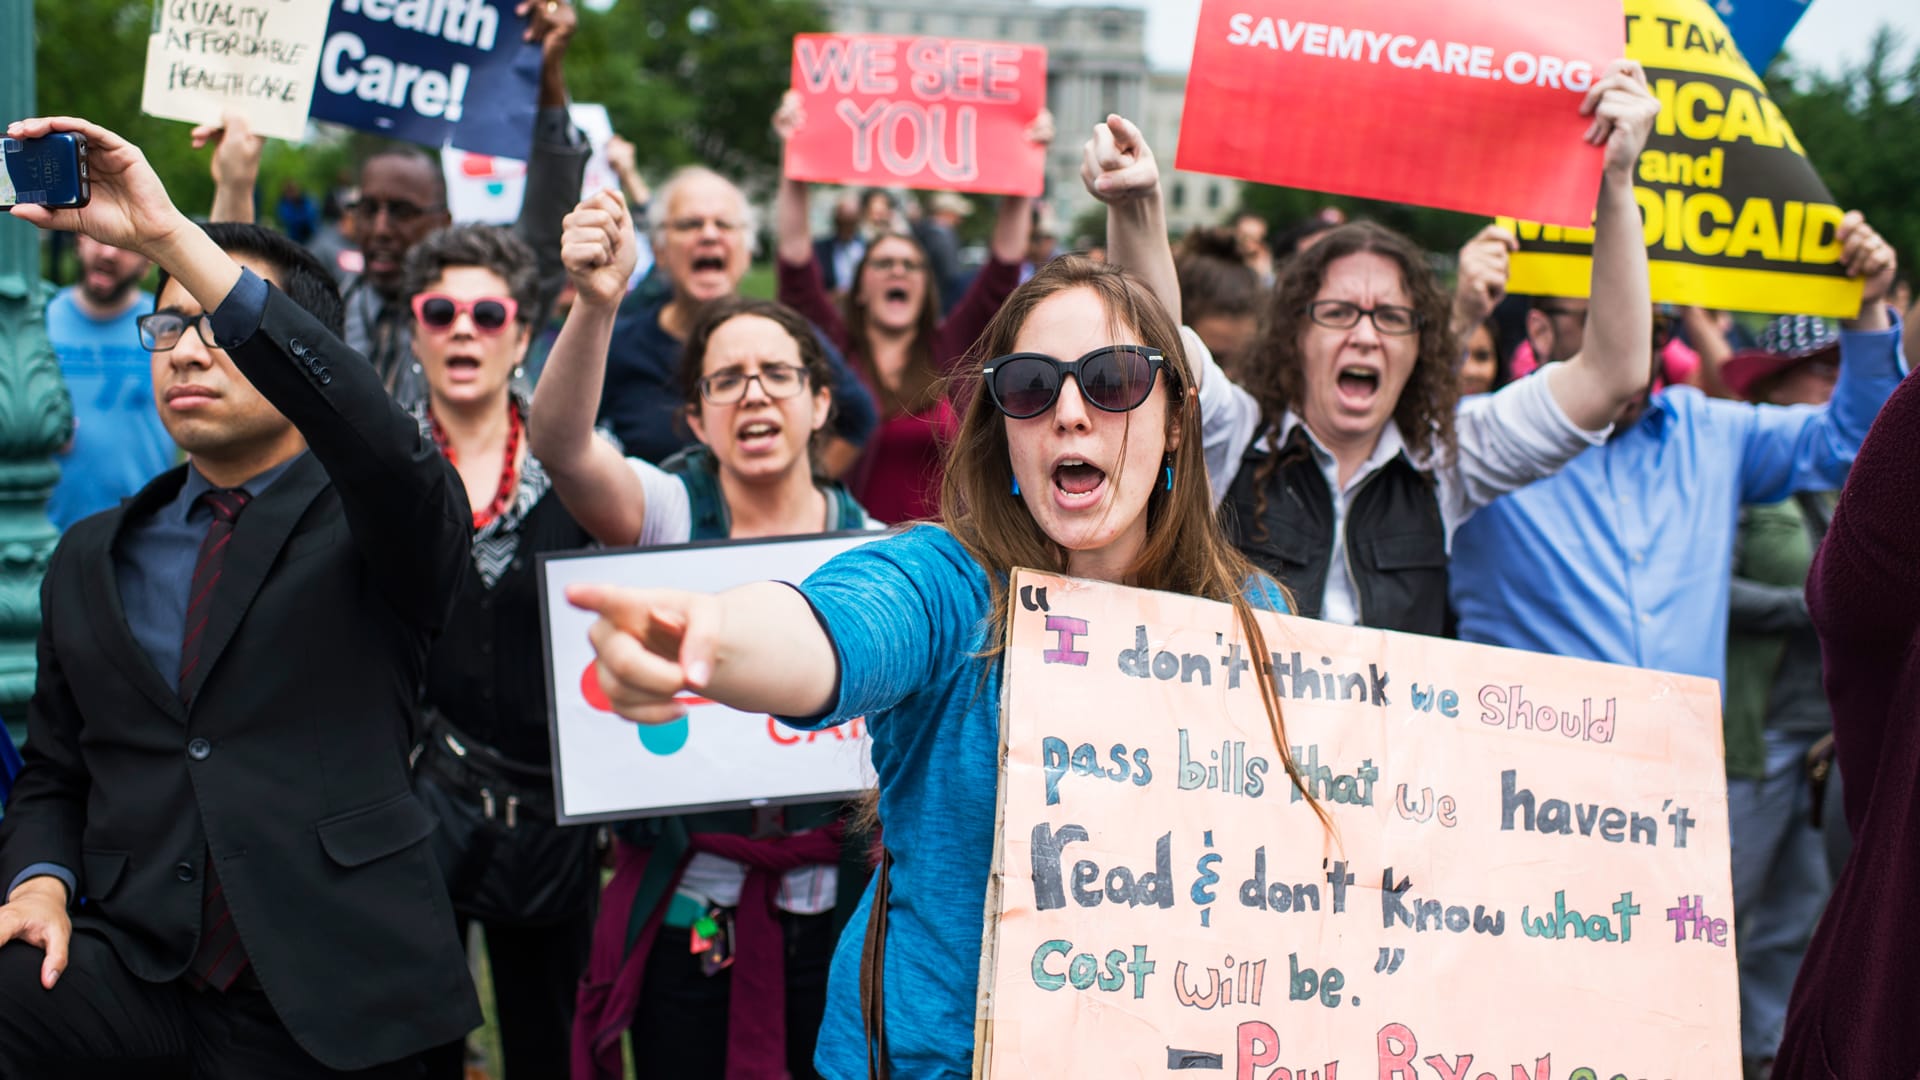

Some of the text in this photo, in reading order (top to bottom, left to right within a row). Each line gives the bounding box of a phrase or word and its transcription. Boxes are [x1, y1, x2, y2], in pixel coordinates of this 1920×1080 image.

[165, 28, 308, 65] AFFORDABLE
[169, 0, 268, 36] QUALITY
[1227, 12, 1593, 92] SAVEMYCARE.ORG
[320, 31, 470, 122] Care!
[796, 38, 1023, 104] WE SEE
[835, 98, 979, 182] YOU
[1638, 147, 1725, 189] and
[1118, 625, 1249, 689] don't
[1262, 651, 1392, 707] think
[1411, 682, 1460, 718] we
[1042, 736, 1152, 806] pass
[1178, 728, 1268, 799] bills
[1285, 744, 1380, 808] that
[1500, 769, 1697, 848] haven't
[1239, 845, 1355, 914] don't
[1521, 890, 1641, 943] what
[1666, 895, 1728, 947] the
